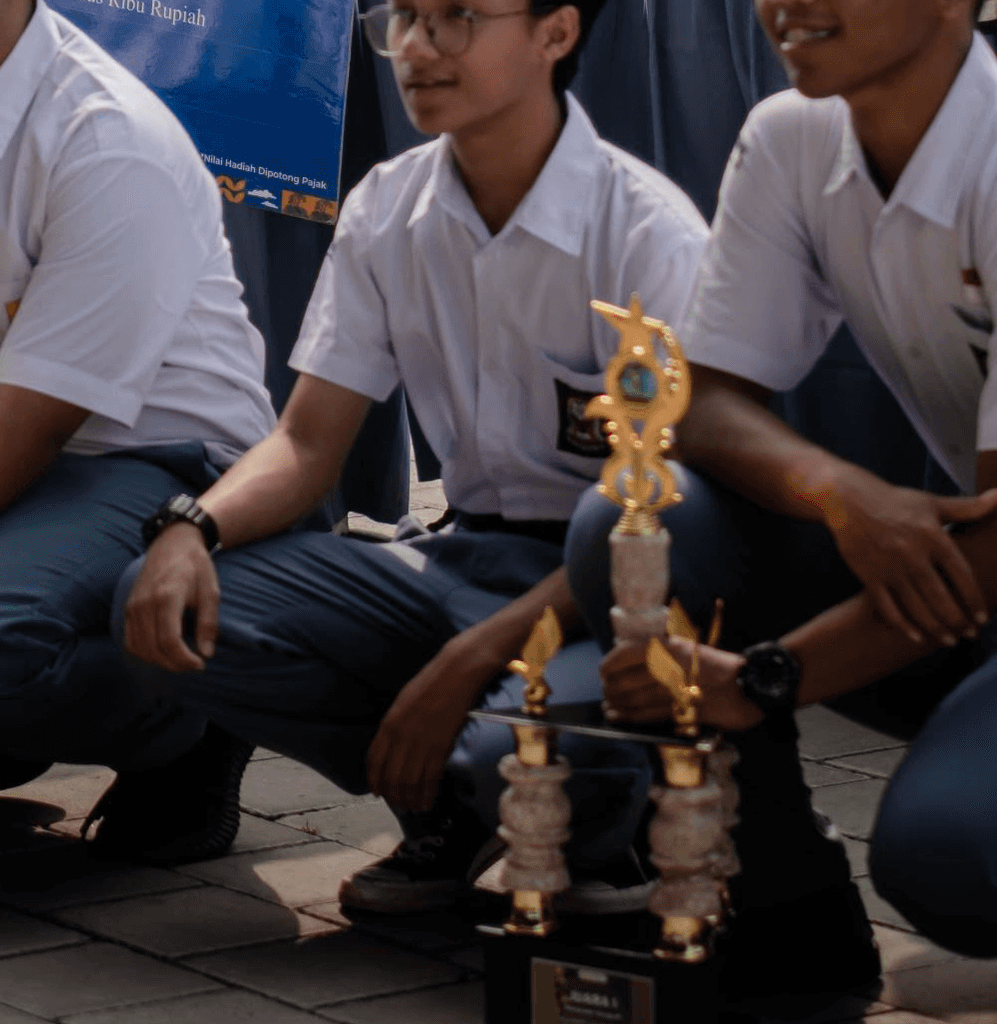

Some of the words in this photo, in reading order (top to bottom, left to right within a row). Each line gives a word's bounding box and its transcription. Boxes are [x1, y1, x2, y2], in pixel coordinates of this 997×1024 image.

[225, 159, 256, 173] Hadiah
[258, 166, 300, 185] Dipotong
[302, 176, 327, 190] Pajak
